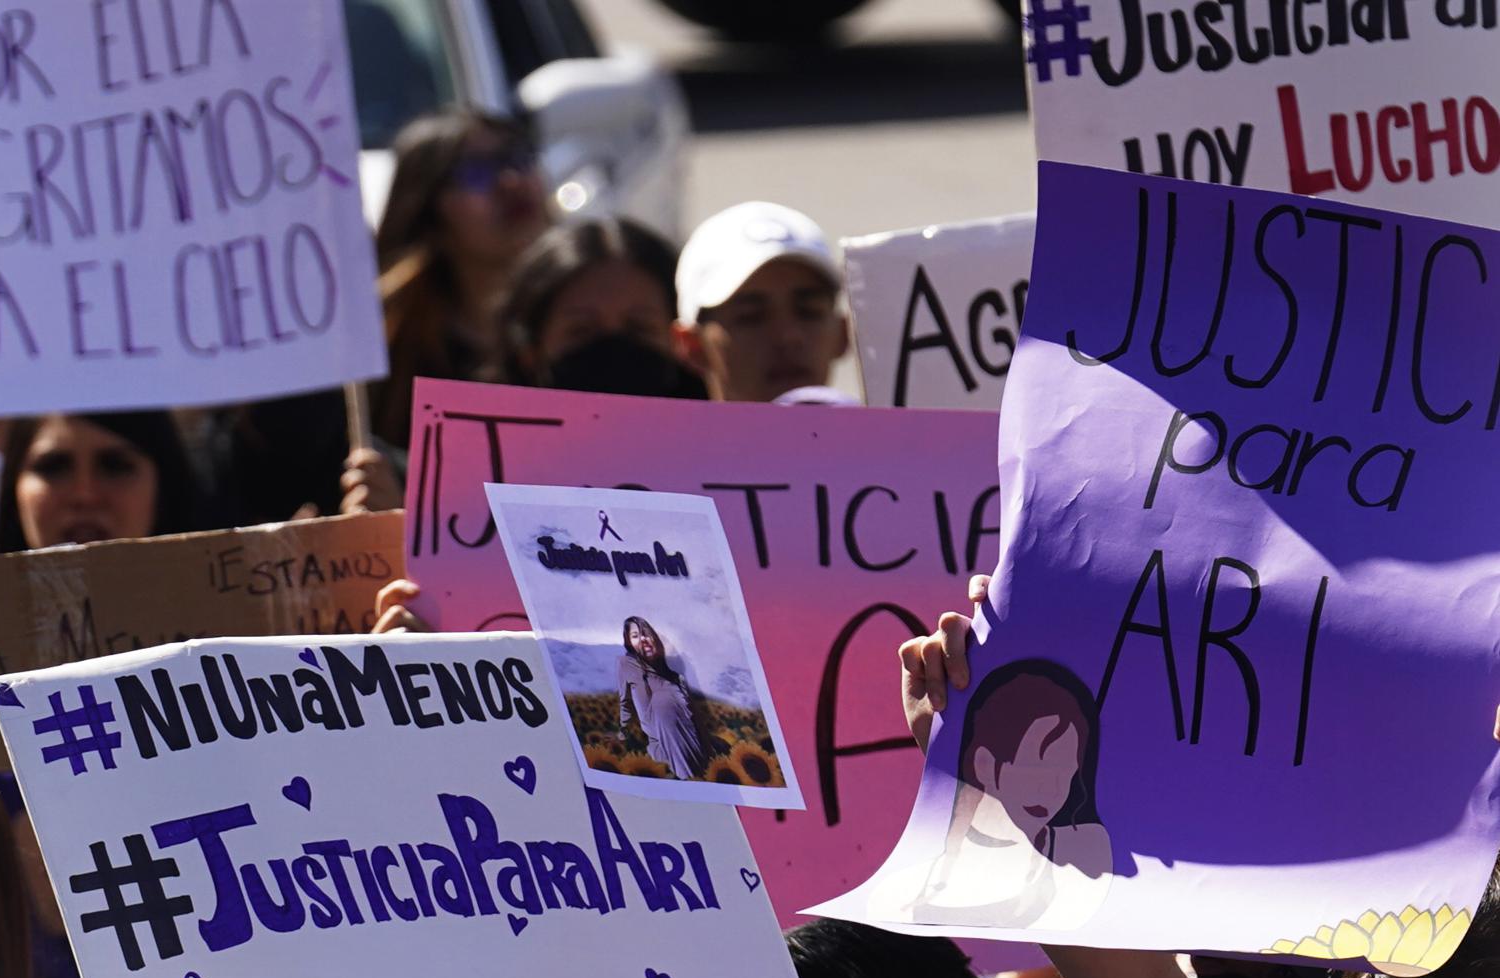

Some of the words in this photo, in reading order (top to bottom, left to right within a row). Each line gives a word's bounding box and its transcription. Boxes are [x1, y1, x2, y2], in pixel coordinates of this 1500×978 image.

[95, 0, 252, 92] ELLA
[1276, 83, 1500, 195] LUCHO
[64, 259, 158, 361] EL
[172, 222, 338, 358] CIELO
[893, 263, 1028, 406] AG
[1143, 409, 1416, 512] para
[1096, 548, 1330, 767] ARI
